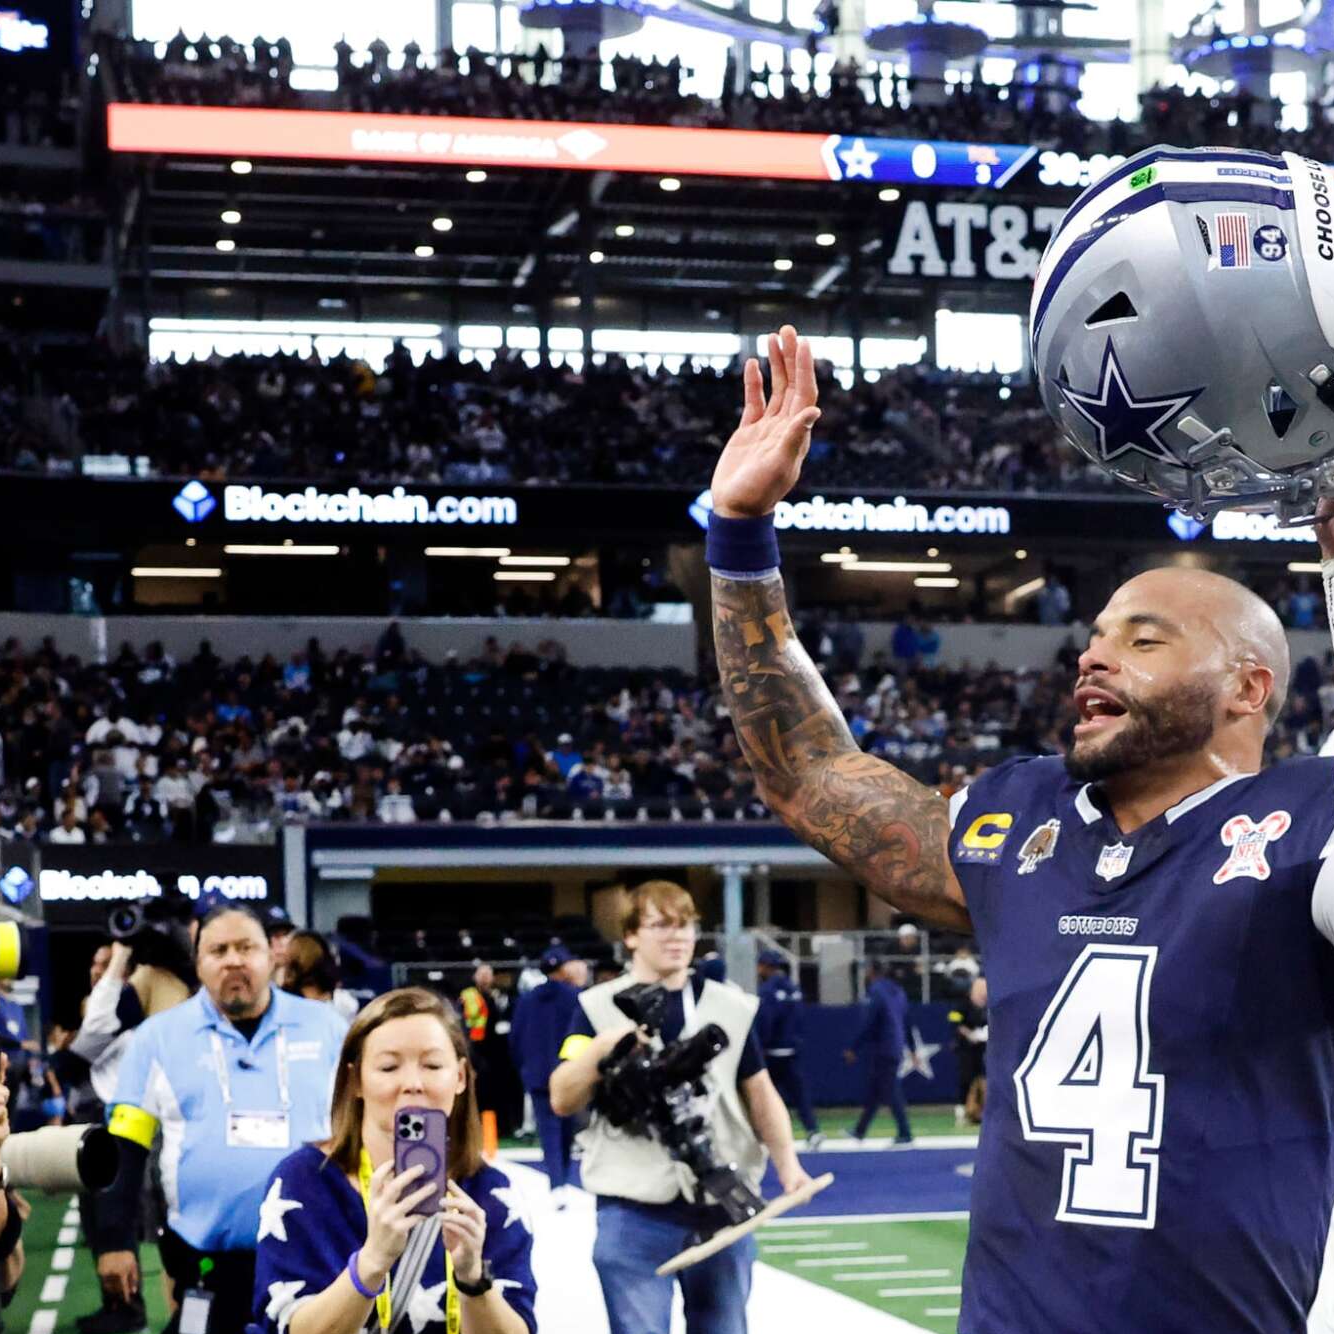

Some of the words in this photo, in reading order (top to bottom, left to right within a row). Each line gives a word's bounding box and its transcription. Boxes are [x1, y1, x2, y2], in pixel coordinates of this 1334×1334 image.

[912, 144, 936, 179] 0
[1310, 171, 1334, 262] CHOOSE
[1259, 226, 1282, 258] 94
[224, 485, 517, 524] Blockchain.com
[774, 495, 1010, 533] ockchain.com
[962, 813, 1013, 850] C
[1058, 914, 1140, 936] COWBOYS
[1012, 944, 1165, 1230] 4
